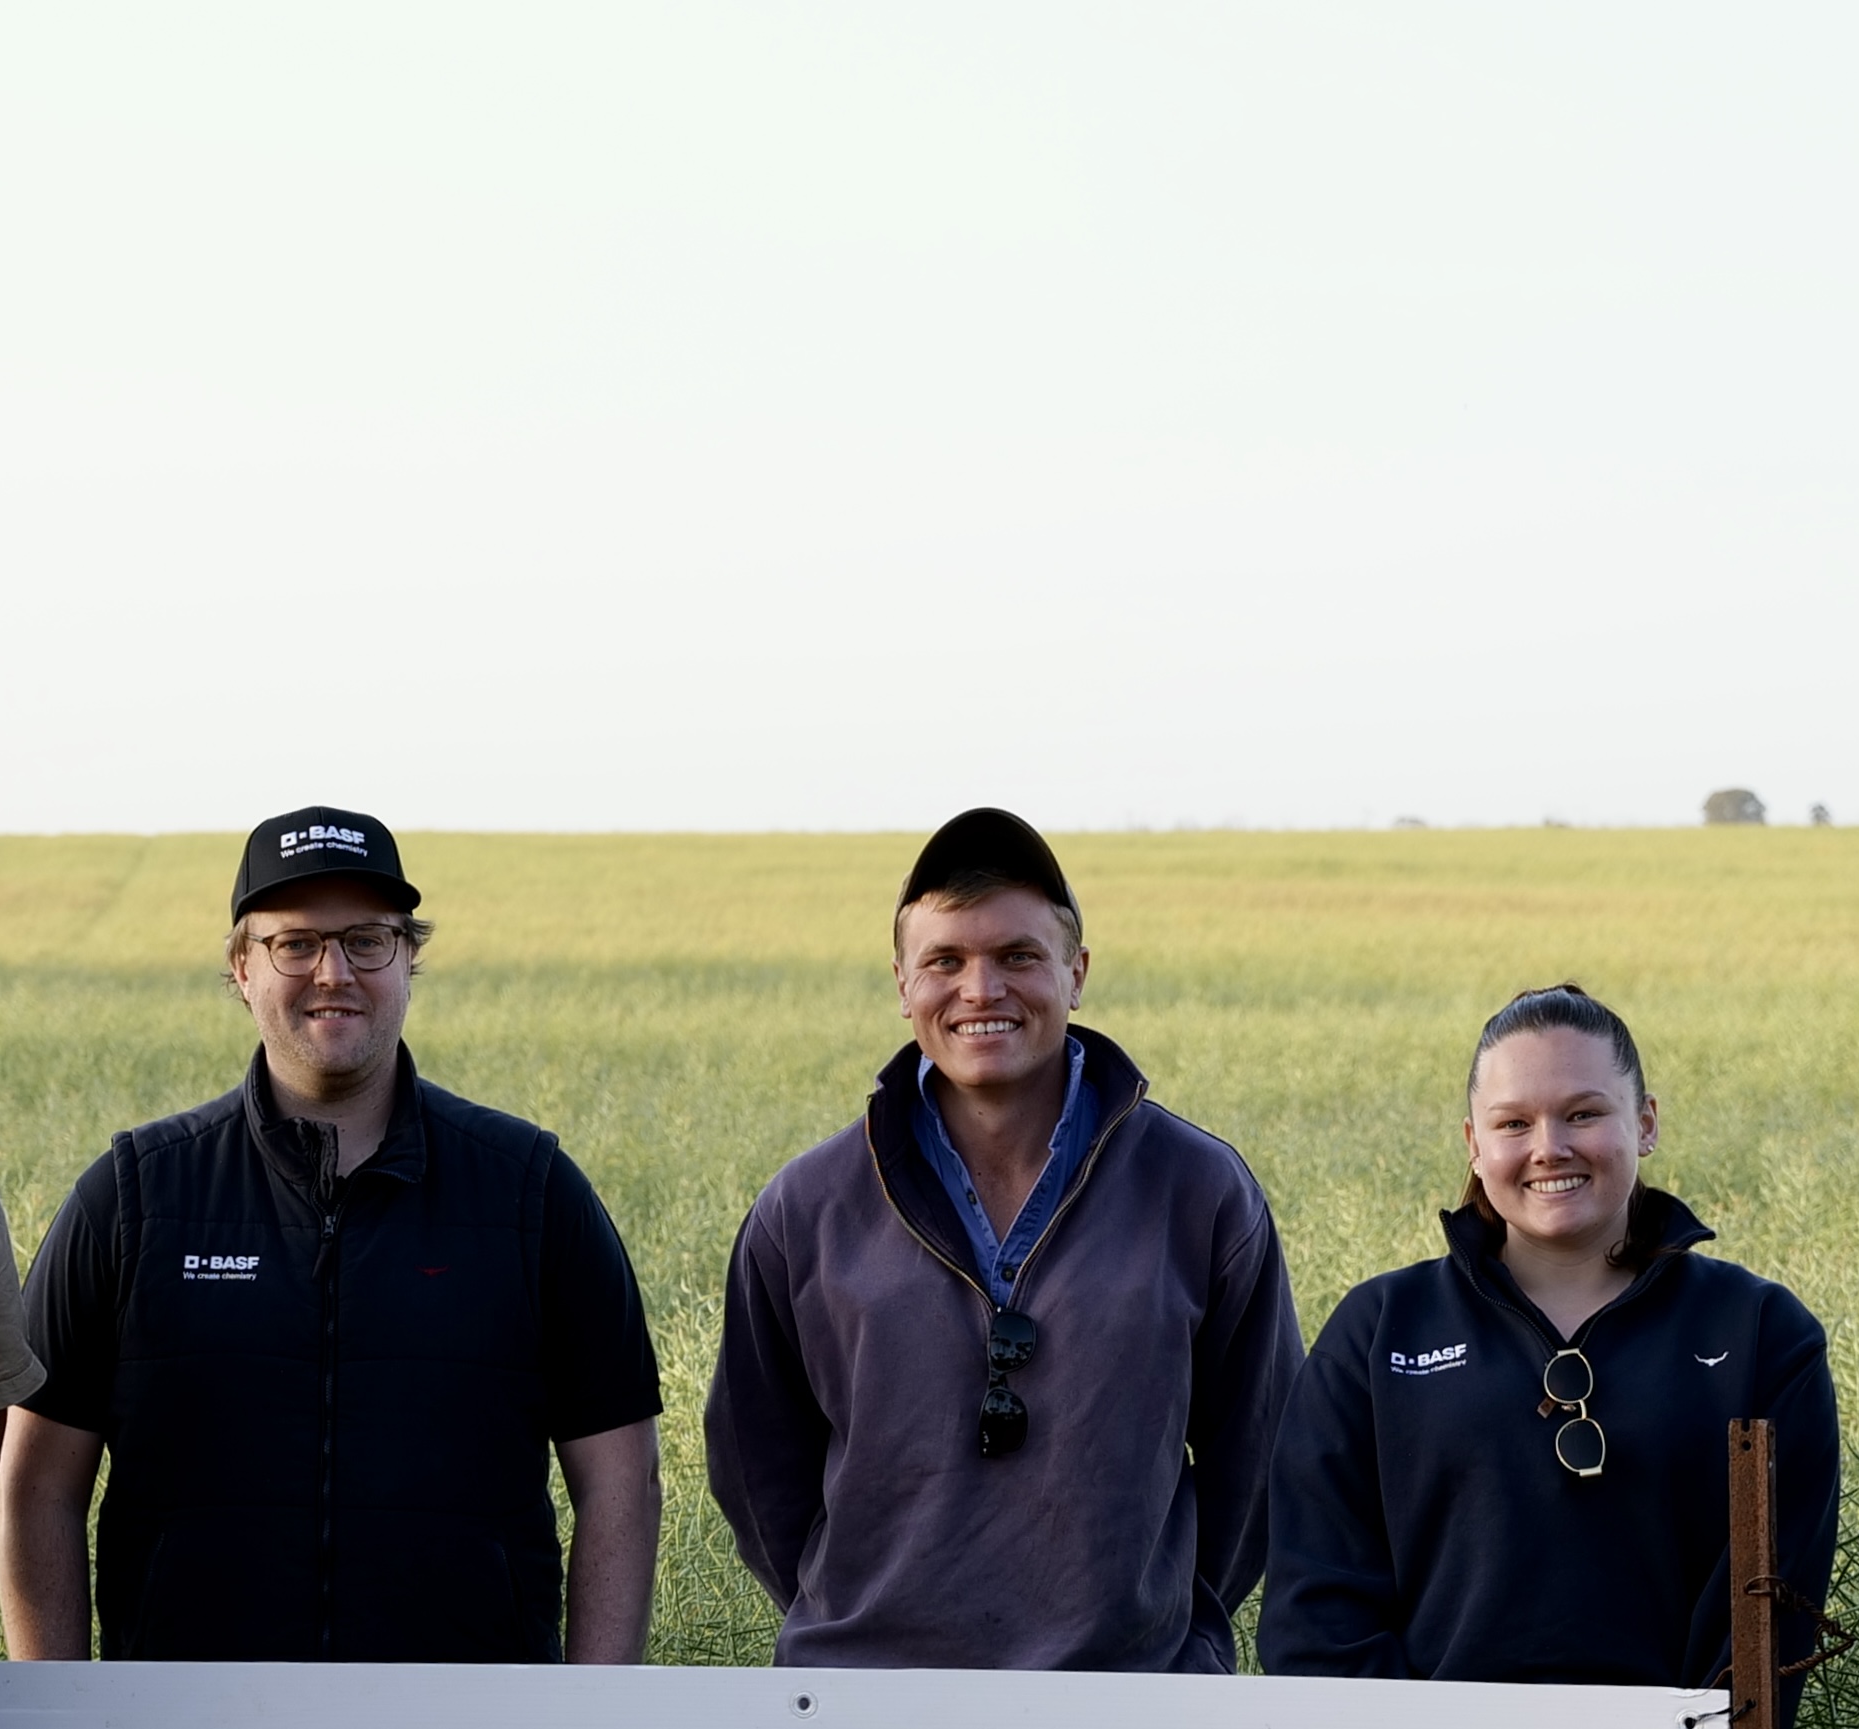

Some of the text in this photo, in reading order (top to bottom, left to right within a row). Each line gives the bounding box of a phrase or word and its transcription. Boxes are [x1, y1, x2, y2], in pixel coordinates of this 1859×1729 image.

[309, 825, 365, 844] BASF
[280, 842, 368, 859] We create chemistry
[210, 1255, 260, 1270] BASF
[183, 1271, 195, 1280] We
[1417, 1343, 1468, 1367] BASF
